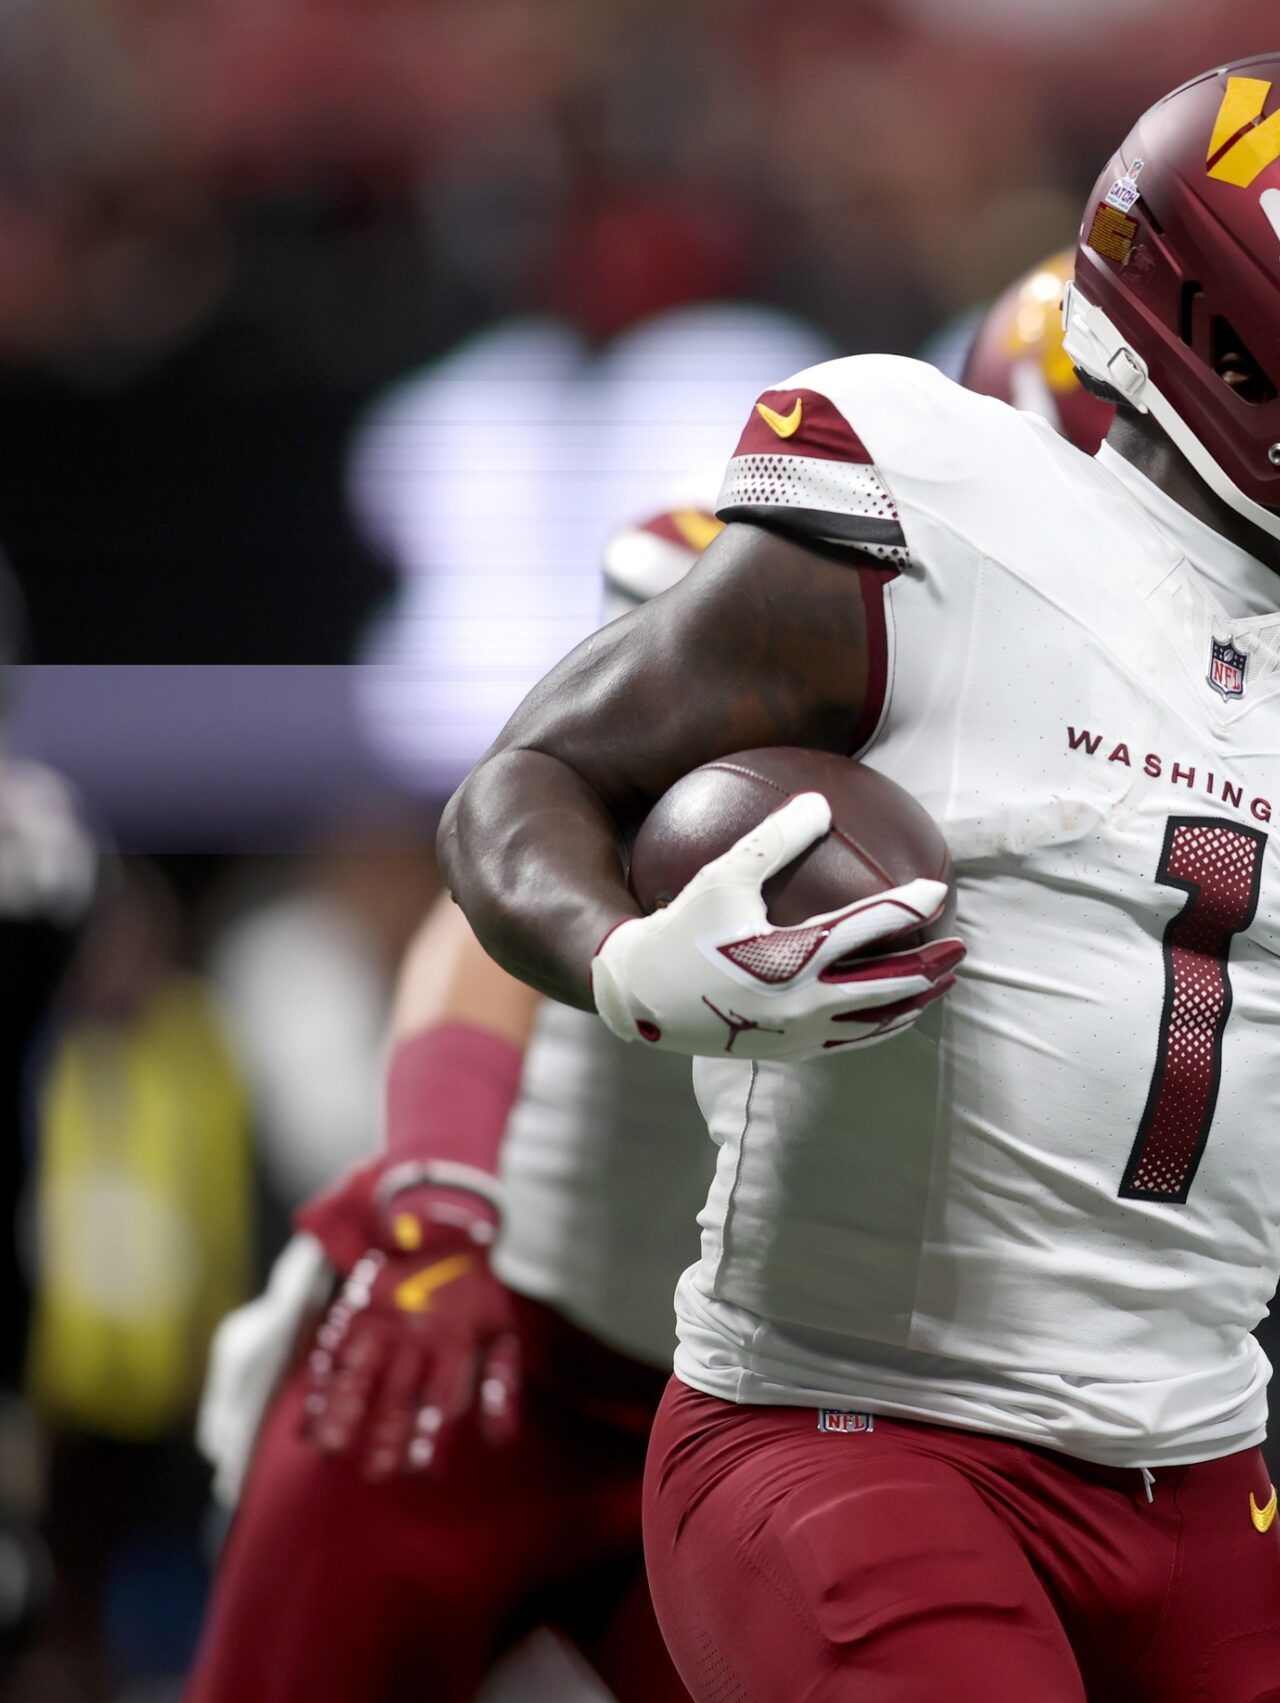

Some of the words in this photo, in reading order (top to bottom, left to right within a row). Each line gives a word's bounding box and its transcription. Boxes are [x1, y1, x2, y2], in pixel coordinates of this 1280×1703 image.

[1214, 660, 1240, 690] NFL
[1118, 815, 1268, 1204] 1
[828, 1413, 865, 1430] NFL
